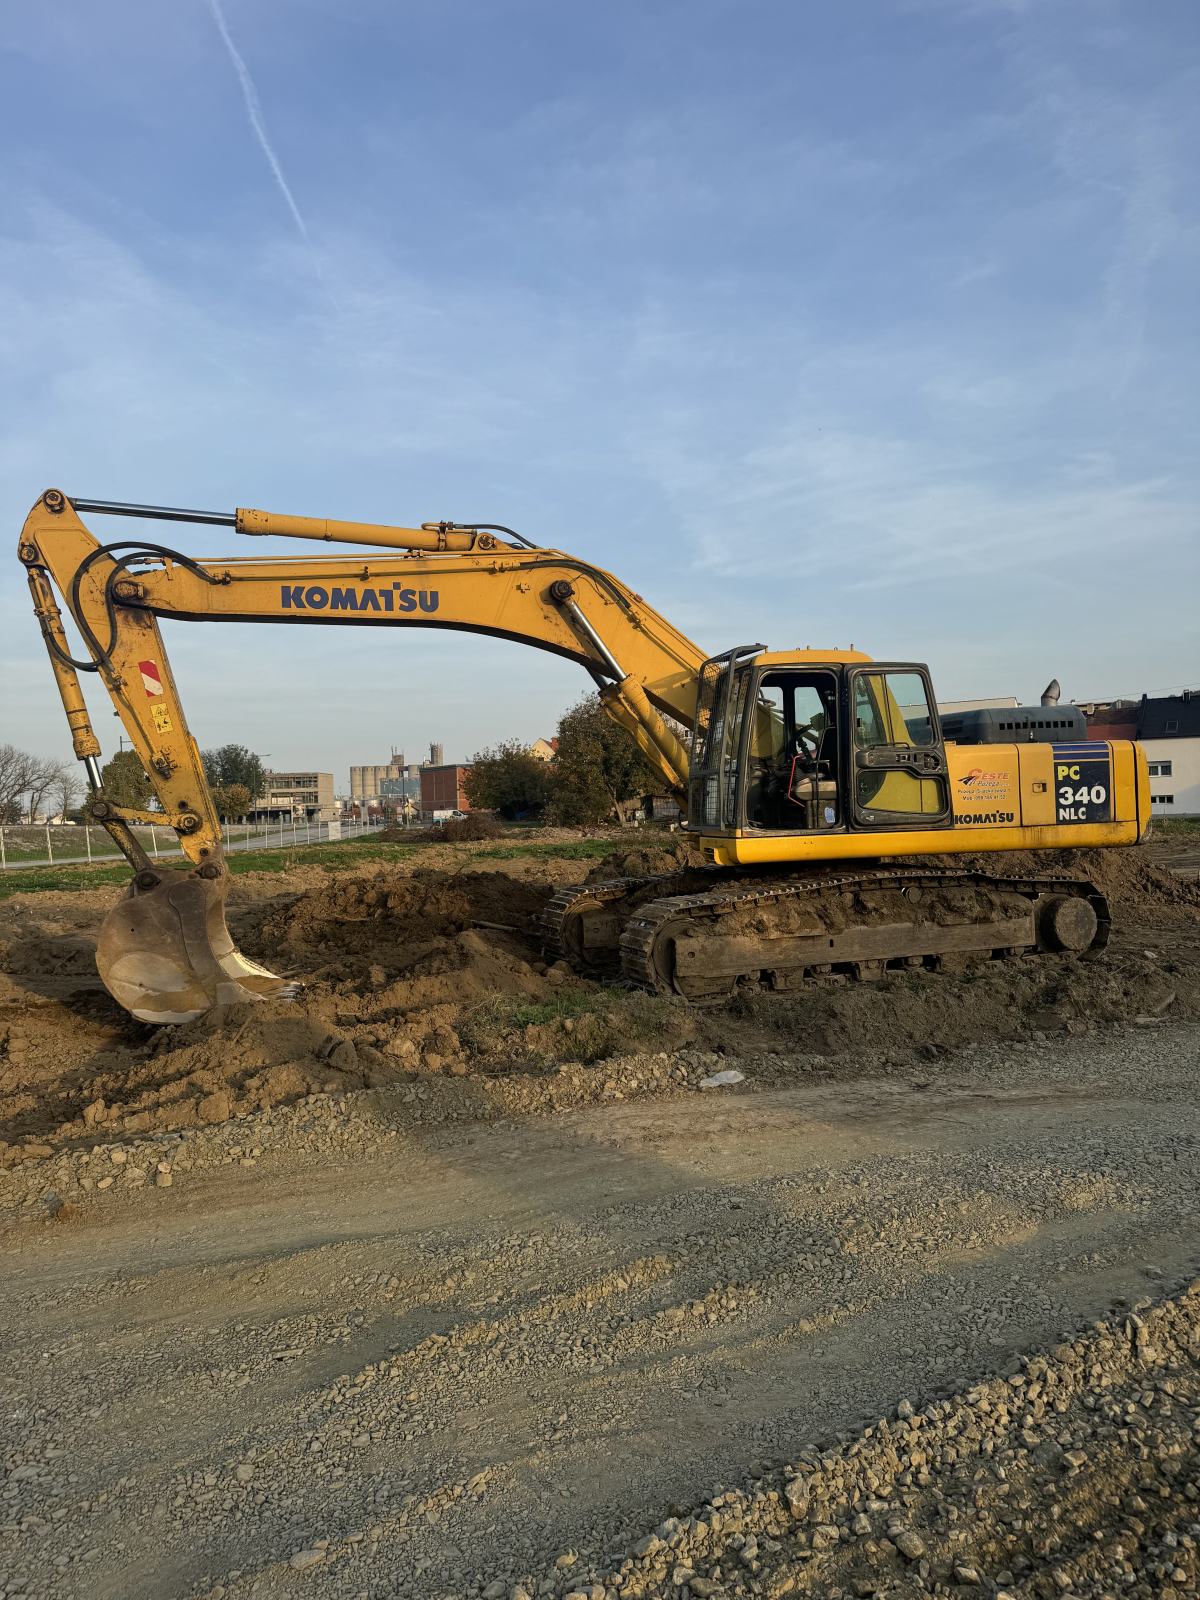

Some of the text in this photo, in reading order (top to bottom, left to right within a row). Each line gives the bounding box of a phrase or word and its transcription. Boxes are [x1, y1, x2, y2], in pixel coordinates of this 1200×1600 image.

[281, 582, 439, 612] KOMATSU
[1057, 765, 1080, 781] PC
[1058, 785, 1106, 805] 340
[954, 810, 1014, 824] KOMATSU
[1059, 807, 1087, 820] NLC
